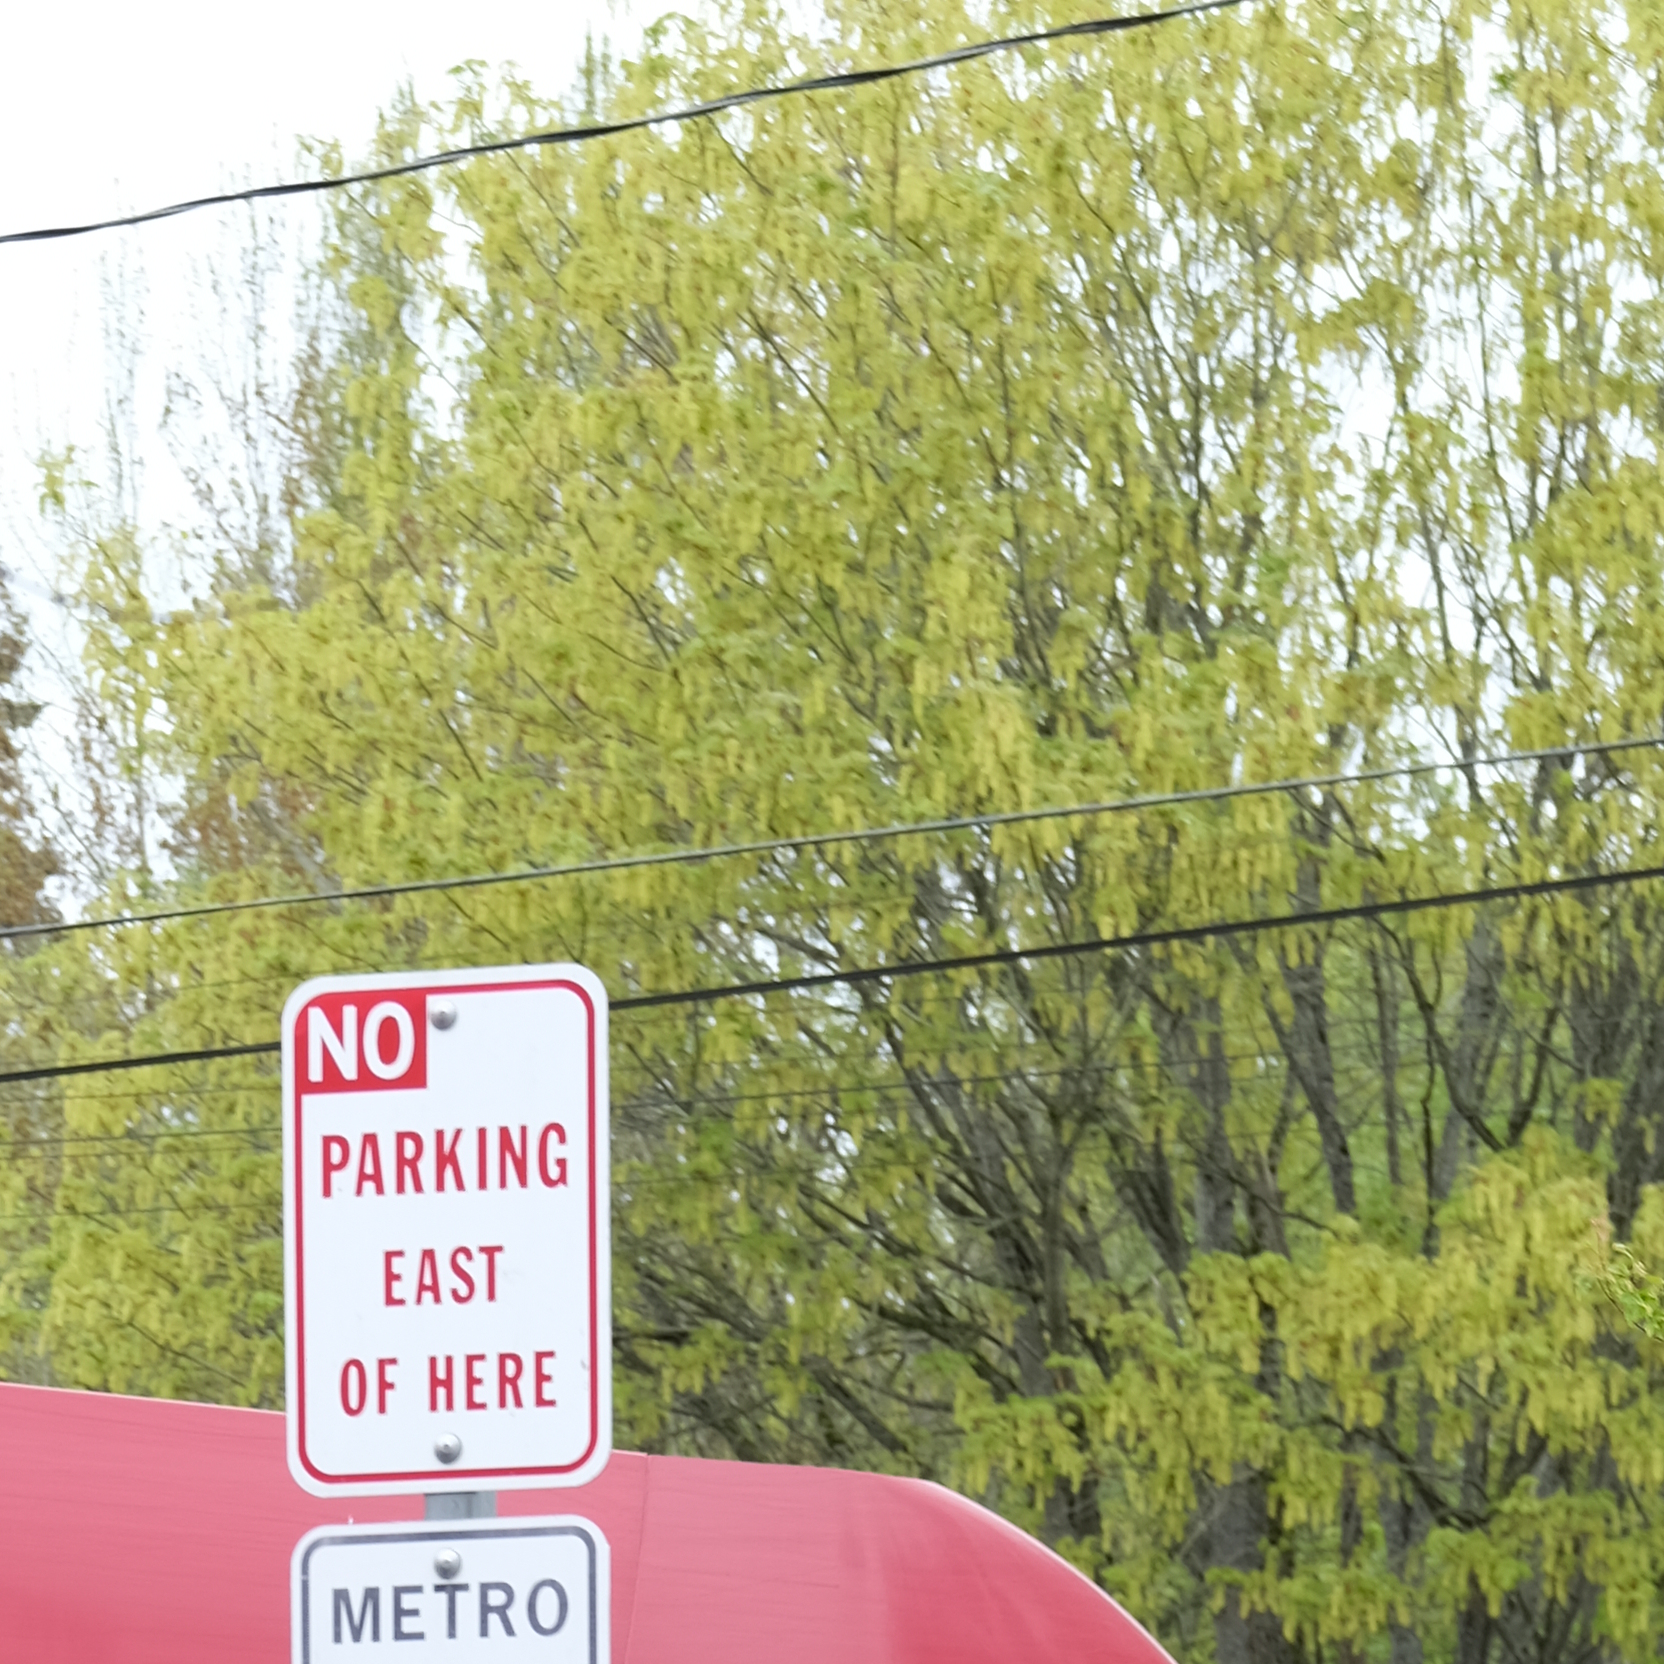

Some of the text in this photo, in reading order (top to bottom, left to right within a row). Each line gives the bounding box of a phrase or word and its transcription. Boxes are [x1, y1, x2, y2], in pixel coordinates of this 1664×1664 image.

[306, 1000, 416, 1083] NO
[321, 1122, 569, 1199] PARKING
[383, 1245, 504, 1308] EAST
[339, 1350, 557, 1418] OF HERE
[331, 1577, 569, 1644] METRO
